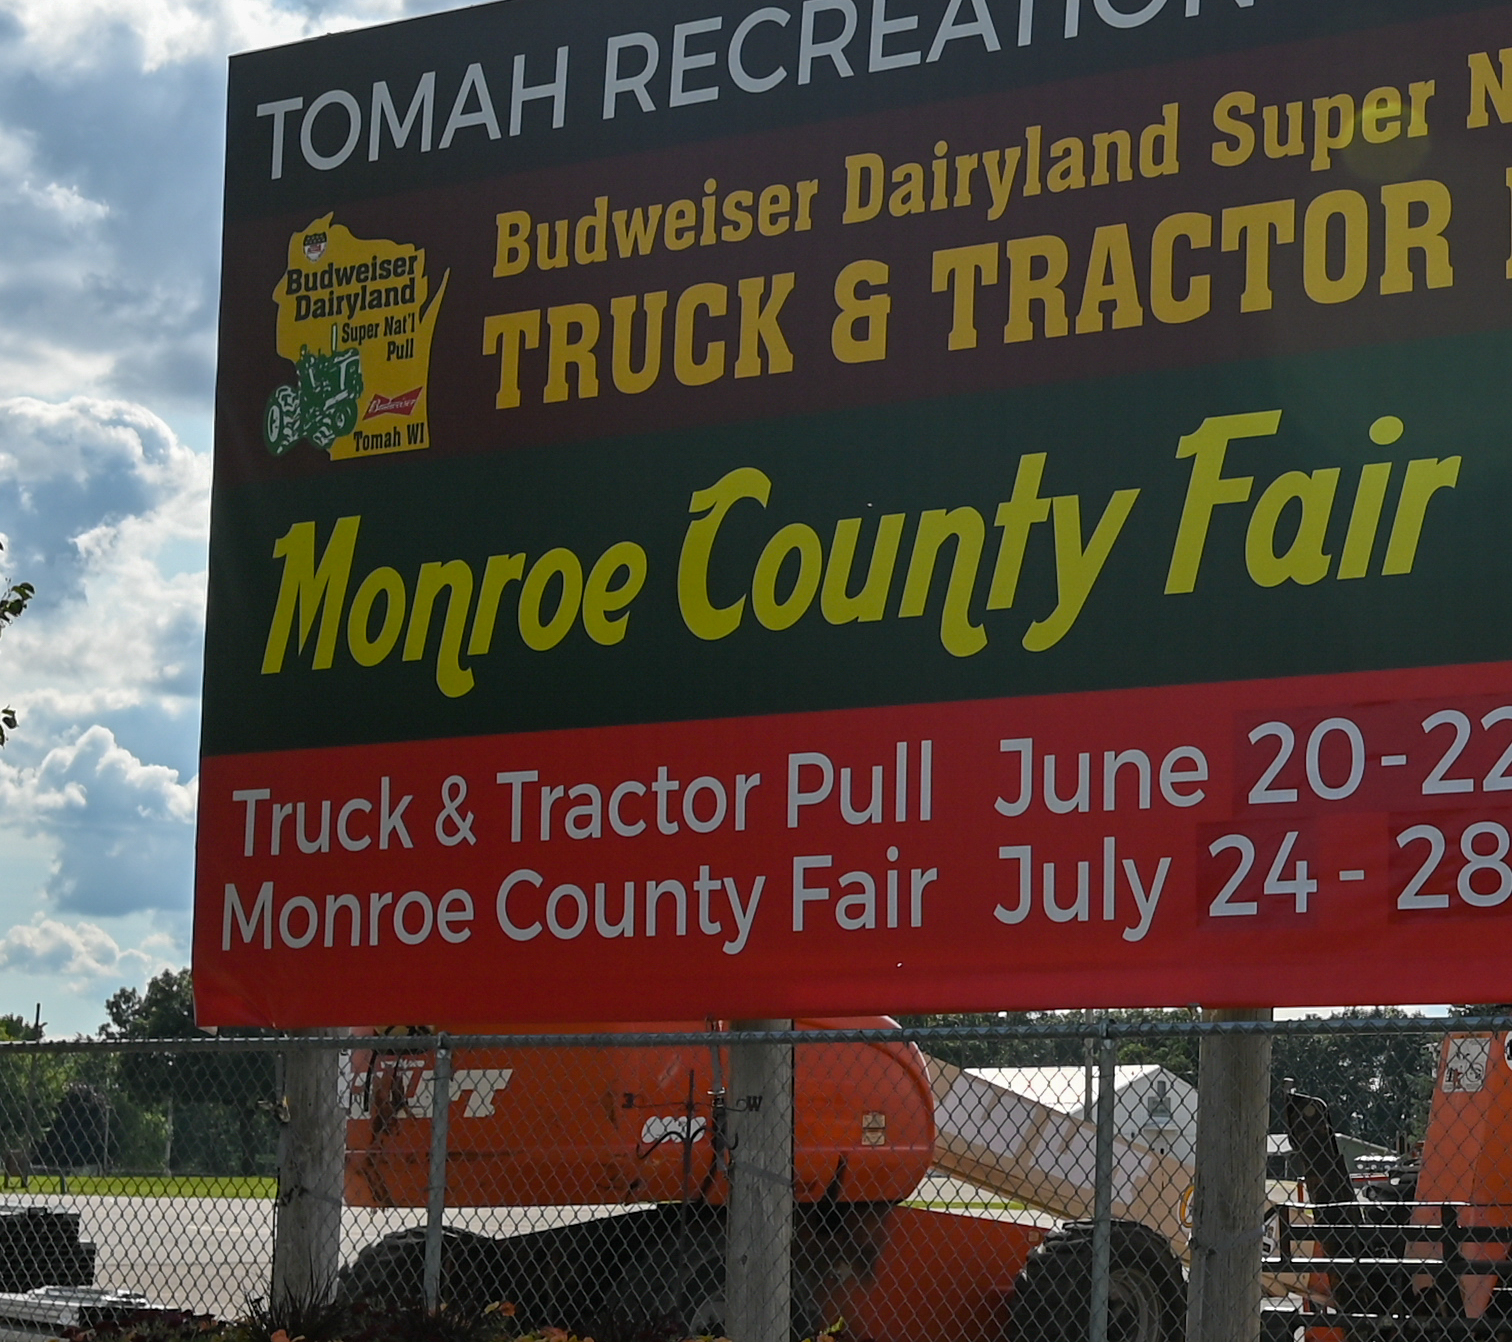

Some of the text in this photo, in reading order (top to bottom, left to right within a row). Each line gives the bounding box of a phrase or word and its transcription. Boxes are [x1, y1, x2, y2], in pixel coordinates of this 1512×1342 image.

[257, 46, 568, 179] TOMAH
[494, 179, 818, 277] Budweiser
[844, 104, 1179, 223] Dairyland
[1212, 81, 1434, 171] Super
[286, 255, 418, 295] Budweiser
[294, 277, 416, 322] Dairyland
[341, 313, 416, 346] Super Nat'l
[482, 273, 794, 409] TRUCK
[831, 261, 890, 363] &
[932, 178, 1453, 350] TRACTOR
[386, 338, 414, 362] Pull
[353, 422, 425, 452] Tomah WI
[262, 410, 1461, 697] Monroe County Fair
[233, 778, 413, 857] Truck
[435, 776, 476, 846] &
[498, 767, 759, 841] Tractor
[788, 740, 931, 827] Pull
[994, 738, 1207, 816] June
[221, 881, 474, 951] Monroe
[498, 866, 765, 954] County
[794, 847, 936, 931] Fair
[994, 837, 1171, 941] July
